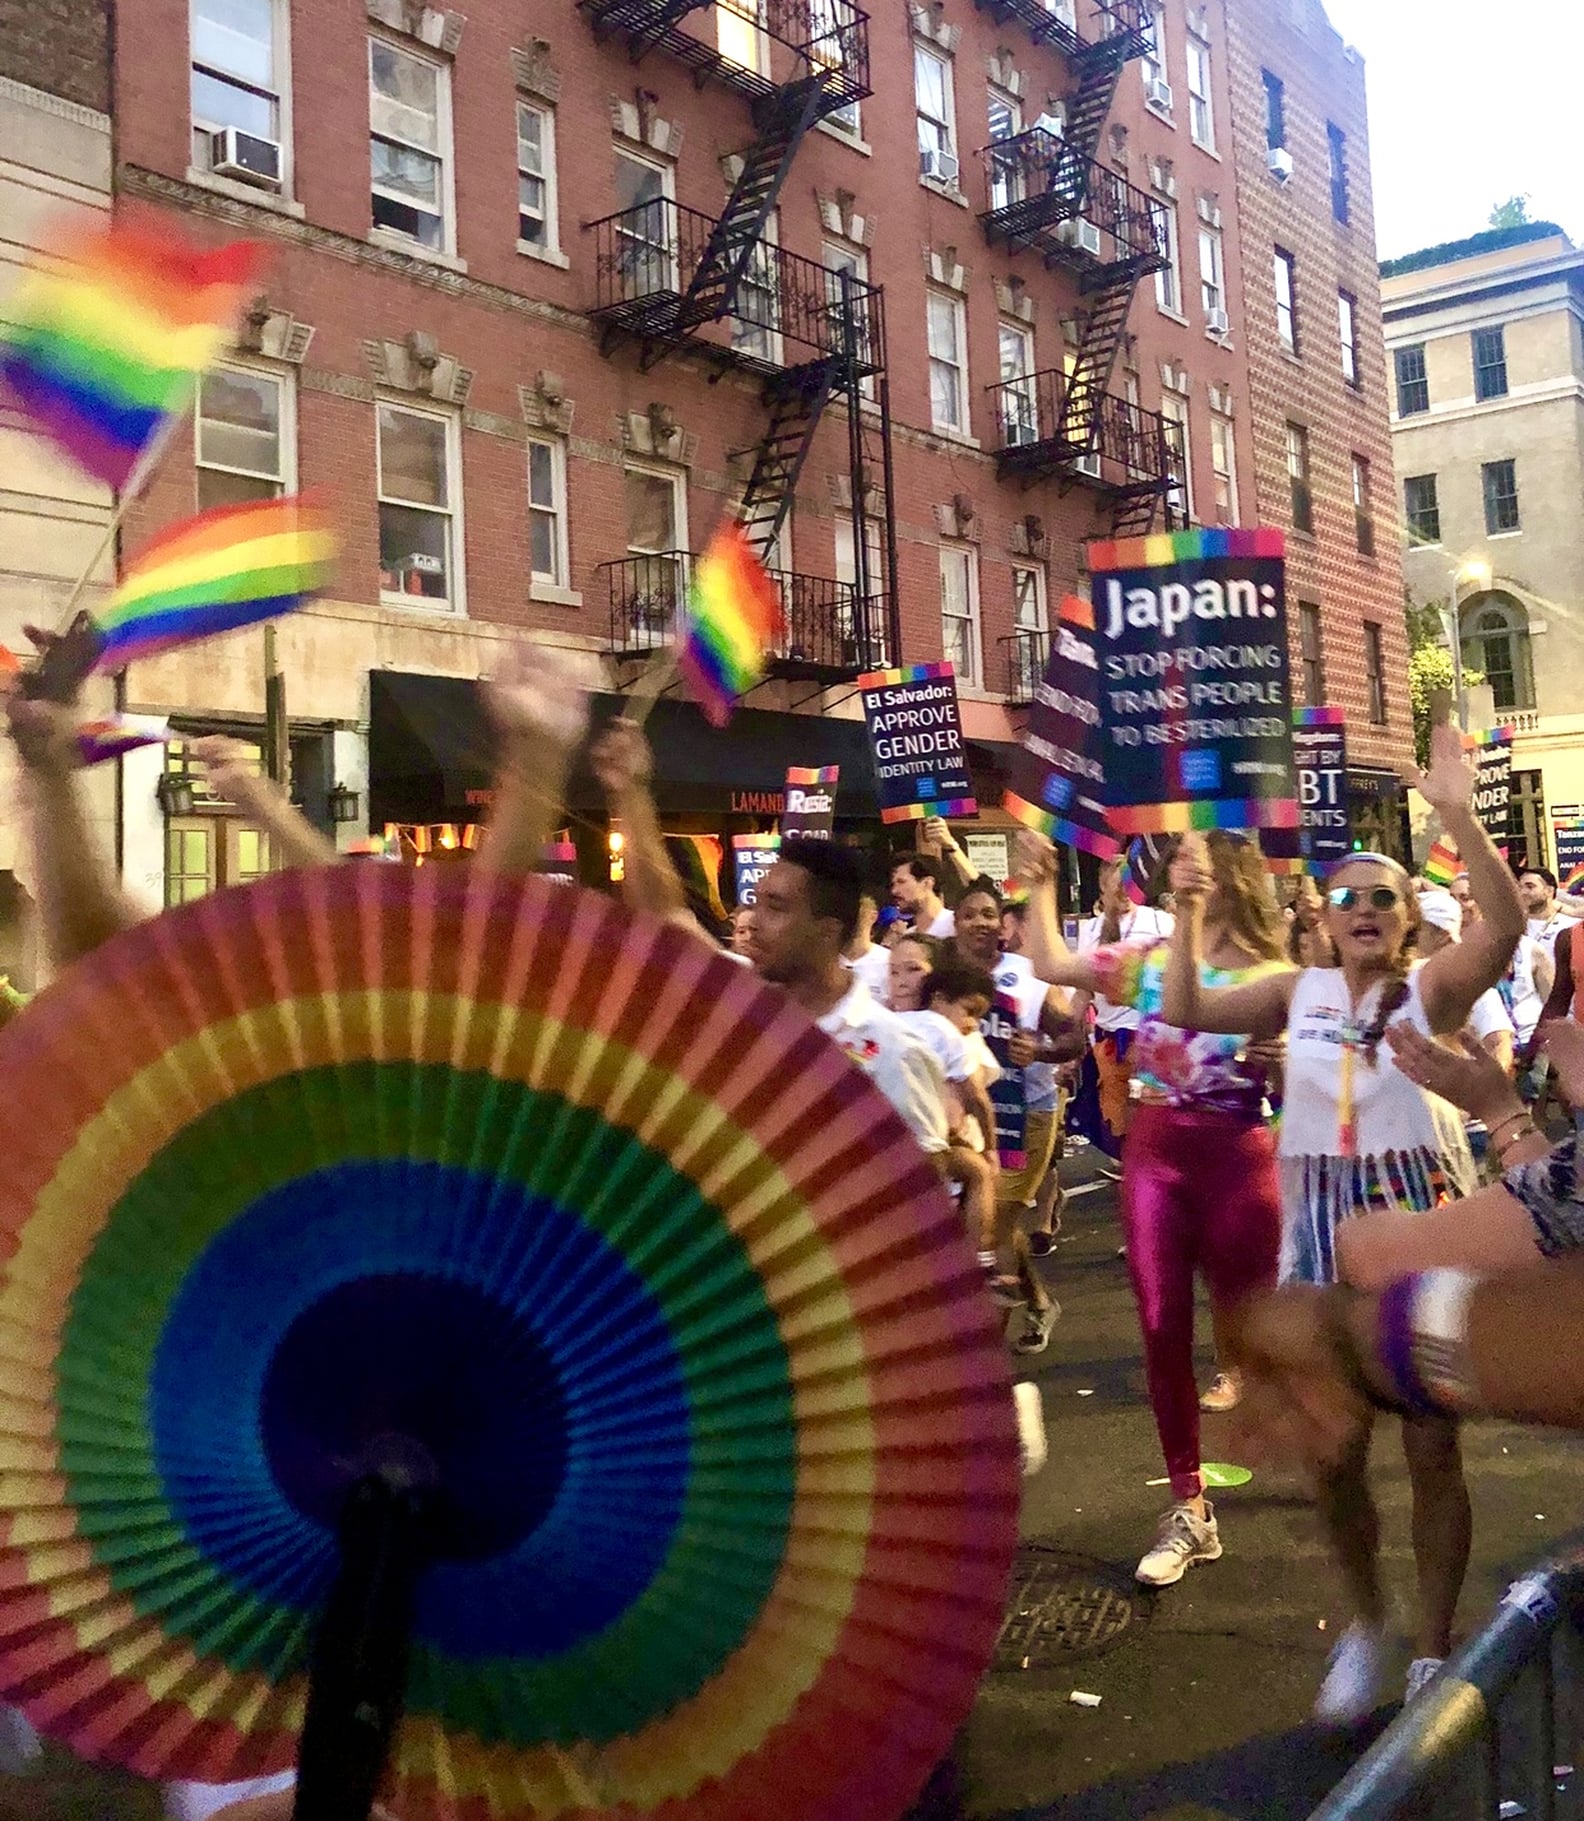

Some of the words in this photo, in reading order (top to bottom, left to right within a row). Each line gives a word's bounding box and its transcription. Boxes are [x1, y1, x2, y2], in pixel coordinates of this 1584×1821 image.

[1103, 577, 1277, 640] Japan:
[1104, 651, 1173, 680] STOP
[1173, 644, 1282, 672] FORCING
[866, 693, 882, 709] El
[884, 685, 953, 707] Salvador:
[1108, 685, 1188, 714] TRANS
[1190, 681, 1283, 706] PEOPLE
[872, 705, 957, 733] APPROVE
[1111, 725, 1142, 746] TO
[1143, 722, 1171, 745] BE
[1170, 717, 1287, 742] STERILIZED
[875, 730, 961, 759] GENDER
[879, 760, 935, 779] IDENTITY
[937, 756, 965, 771] LAW
[1299, 769, 1343, 805] BT
